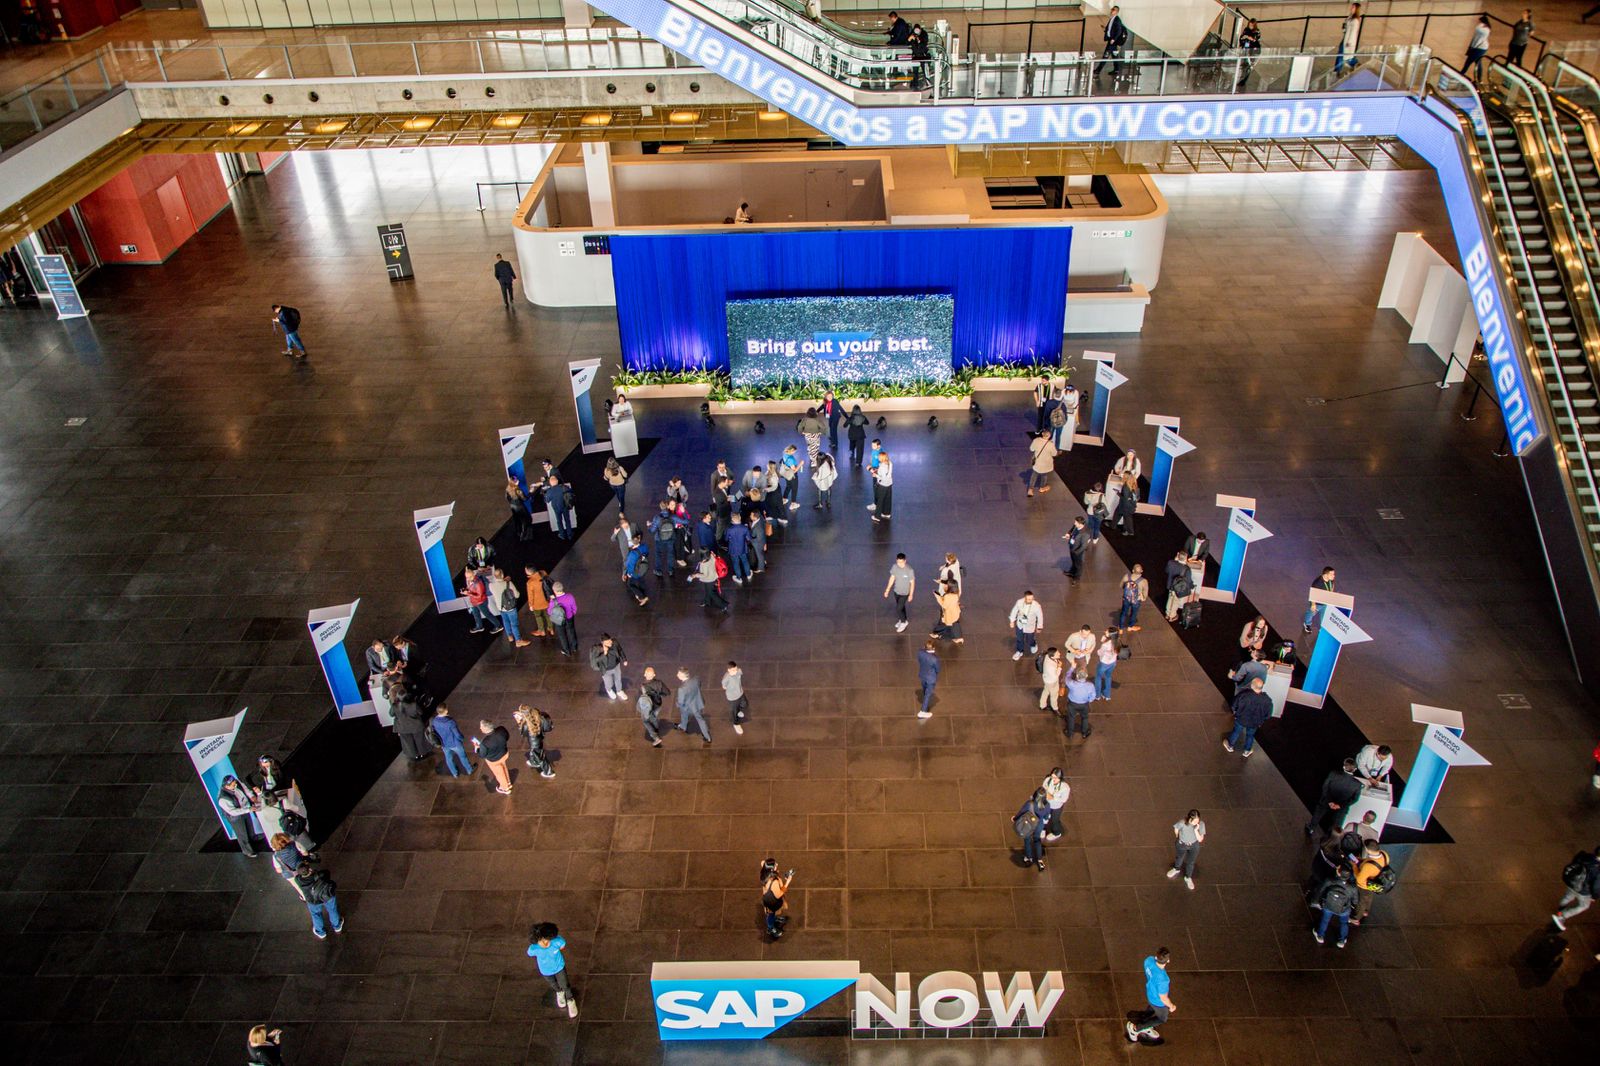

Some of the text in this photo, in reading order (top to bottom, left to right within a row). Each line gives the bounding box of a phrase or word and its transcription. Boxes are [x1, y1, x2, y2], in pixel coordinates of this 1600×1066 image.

[906, 115, 928, 140] a
[941, 106, 1029, 140] SAP
[1041, 103, 1148, 138] NOW
[1157, 101, 1363, 135] Colombia.
[747, 337, 932, 357] Bring out your best.
[319, 620, 341, 637] INVITADO
[1329, 616, 1348, 634] ESPECIAL
[1330, 612, 1350, 631] INVITADO
[320, 626, 342, 642] ESPECIAL
[201, 739, 225, 759] ESPECIAL
[1434, 734, 1458, 755] ESPECIAL
[1435, 729, 1461, 751] INVITADO
[656, 972, 1064, 1030] SAP NOW
